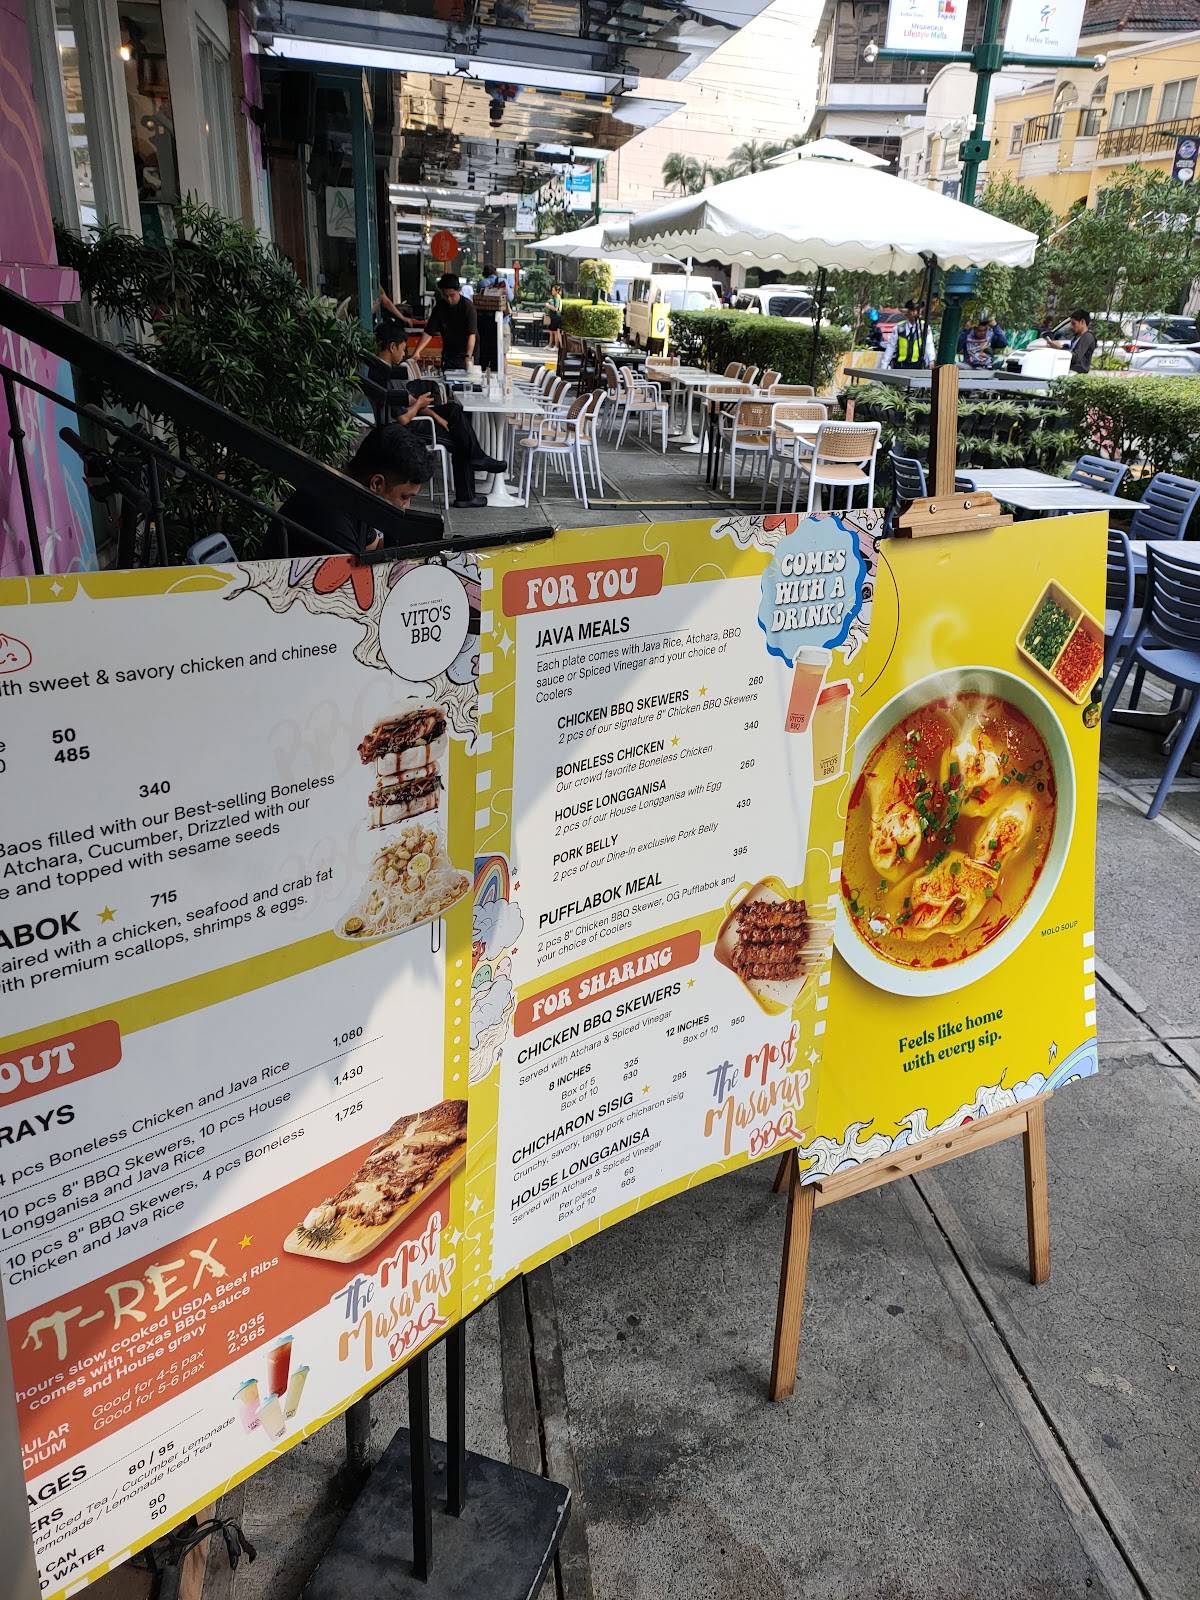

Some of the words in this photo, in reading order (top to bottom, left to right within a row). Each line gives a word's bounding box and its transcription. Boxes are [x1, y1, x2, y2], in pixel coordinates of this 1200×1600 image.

[781, 549, 846, 576] COMES
[526, 575, 578, 609] FOR
[587, 567, 638, 600] YOU
[775, 578, 826, 605] WITH
[830, 576, 845, 598] A
[401, 606, 451, 627] VITO'S
[771, 602, 844, 632] DRINK!
[411, 625, 441, 644] BBQ
[535, 626, 574, 648] JAVA
[579, 617, 630, 640] MEALS
[537, 658, 560, 672] Each
[563, 655, 585, 670] plate
[588, 650, 619, 665] comes
[622, 645, 640, 656] with
[641, 642, 661, 657] Java
[723, 628, 741, 638] BBQ
[29, 672, 89, 693] sweet
[96, 670, 109, 684] &
[116, 665, 174, 682] savory
[180, 656, 244, 675] chicken
[250, 649, 276, 665] and
[282, 642, 336, 660] chinese
[749, 676, 764, 686] 260
[536, 686, 573, 703] Coolers
[557, 707, 607, 729] CHICKEN
[611, 701, 634, 717] BBQ
[637, 690, 689, 710] SKEWERS
[52, 728, 75, 743] 50
[744, 720, 759, 730] 340
[55, 746, 90, 763] 485
[556, 753, 614, 778] BONELESS
[617, 740, 665, 760] CHICKEN
[556, 781, 573, 792] Our
[575, 772, 602, 787] crowd
[605, 762, 637, 780] favorite
[639, 751, 678, 770] Boneless
[680, 744, 713, 759] Chicken
[740, 759, 755, 769] 260
[139, 781, 170, 797] 340
[554, 800, 594, 822] HOUSE
[596, 779, 666, 808] LONGGANISA
[736, 799, 751, 808] 430
[48, 825, 94, 847] filled
[100, 818, 136, 836] with
[142, 812, 169, 827] our
[175, 791, 266, 820] Best-selling
[271, 775, 334, 798] Boneless
[4, 852, 82, 878] Atchara,
[89, 830, 182, 858] Cucumber,
[188, 811, 250, 836] Drizzled
[255, 804, 283, 820] with
[288, 797, 310, 811] our
[553, 846, 583, 866] PORK
[586, 834, 618, 855] BELLY
[733, 846, 748, 857] 395
[16, 875, 50, 895] and
[56, 859, 122, 885] topped
[128, 851, 163, 869] with
[168, 836, 230, 859] sesame
[235, 823, 279, 843] seeds
[54, 938, 91, 958] with
[97, 937, 106, 946] a
[112, 916, 182, 942] chicken,
[186, 893, 248, 921] seafood
[253, 884, 278, 902] and
[283, 875, 312, 893] crab
[316, 868, 333, 882] fat
[150, 890, 176, 907] 715
[539, 885, 622, 928] PUFFLABOK
[625, 873, 662, 896] MEAL
[31, 955, 109, 988] premium
[115, 932, 188, 961] scallops,
[193, 912, 251, 937] shrimps
[257, 906, 266, 918] &
[270, 895, 307, 914] eggs.
[1041, 926, 1060, 936] MOLO
[1061, 921, 1079, 931] SOUP
[531, 989, 572, 1023] FOR
[578, 946, 673, 999] SHARING
[333, 1026, 363, 1047] 1,080
[517, 1023, 579, 1064] CHICKEN
[584, 1010, 612, 1033] BBQ
[616, 982, 681, 1017] SKEWERS
[666, 1028, 675, 1038] 12
[677, 1014, 710, 1034] INCHES
[898, 1031, 935, 1053] Feels
[937, 1021, 963, 1040] like
[966, 1008, 1003, 1030] home
[903, 1050, 935, 1072] with
[938, 1038, 975, 1059] every
[978, 1029, 1002, 1046] sip.
[334, 1065, 363, 1086] 1,430
[549, 1081, 555, 1091] 8
[557, 1063, 591, 1087] INCHES
[672, 1071, 687, 1082] 295
[12, 1162, 44, 1184] pcs
[50, 1129, 127, 1166] Boneless
[132, 1102, 194, 1132] Chicken
[198, 1087, 224, 1106] and
[228, 1075, 257, 1094] Java
[262, 1062, 290, 1080] Rice
[335, 1101, 363, 1122] 1,725
[512, 1110, 595, 1164] CHICHARON
[598, 1092, 633, 1117] SISIG
[749, 1111, 802, 1156] BBQ
[511, 1173, 558, 1211] HOUSE
[562, 1128, 650, 1180] LONGGANISA
[21, 1237, 231, 1361] T-REX
[15, 1372, 64, 1403] hours
[68, 1350, 106, 1375] slow
[111, 1315, 168, 1351] cooked
[172, 1294, 212, 1325] USDA
[215, 1273, 248, 1300] Beef
[250, 1256, 279, 1277] Ribs
[227, 1313, 265, 1342] 2,035
[228, 1325, 265, 1354] 2,365
[388, 1303, 450, 1362] BBQ
[29, 1375, 85, 1410] comes
[90, 1356, 122, 1377] with
[127, 1331, 171, 1356] Texas
[175, 1311, 206, 1332] BBQ
[210, 1286, 250, 1311] sauce
[83, 1376, 112, 1397] and
[116, 1350, 164, 1379] House
[168, 1324, 206, 1356] gravy
[129, 1460, 145, 1475] 80
[150, 1451, 153, 1464] /
[158, 1441, 174, 1456] 95
[149, 1493, 166, 1509] 90
[151, 1504, 167, 1520] 50
[46, 1548, 76, 1572] CAN
